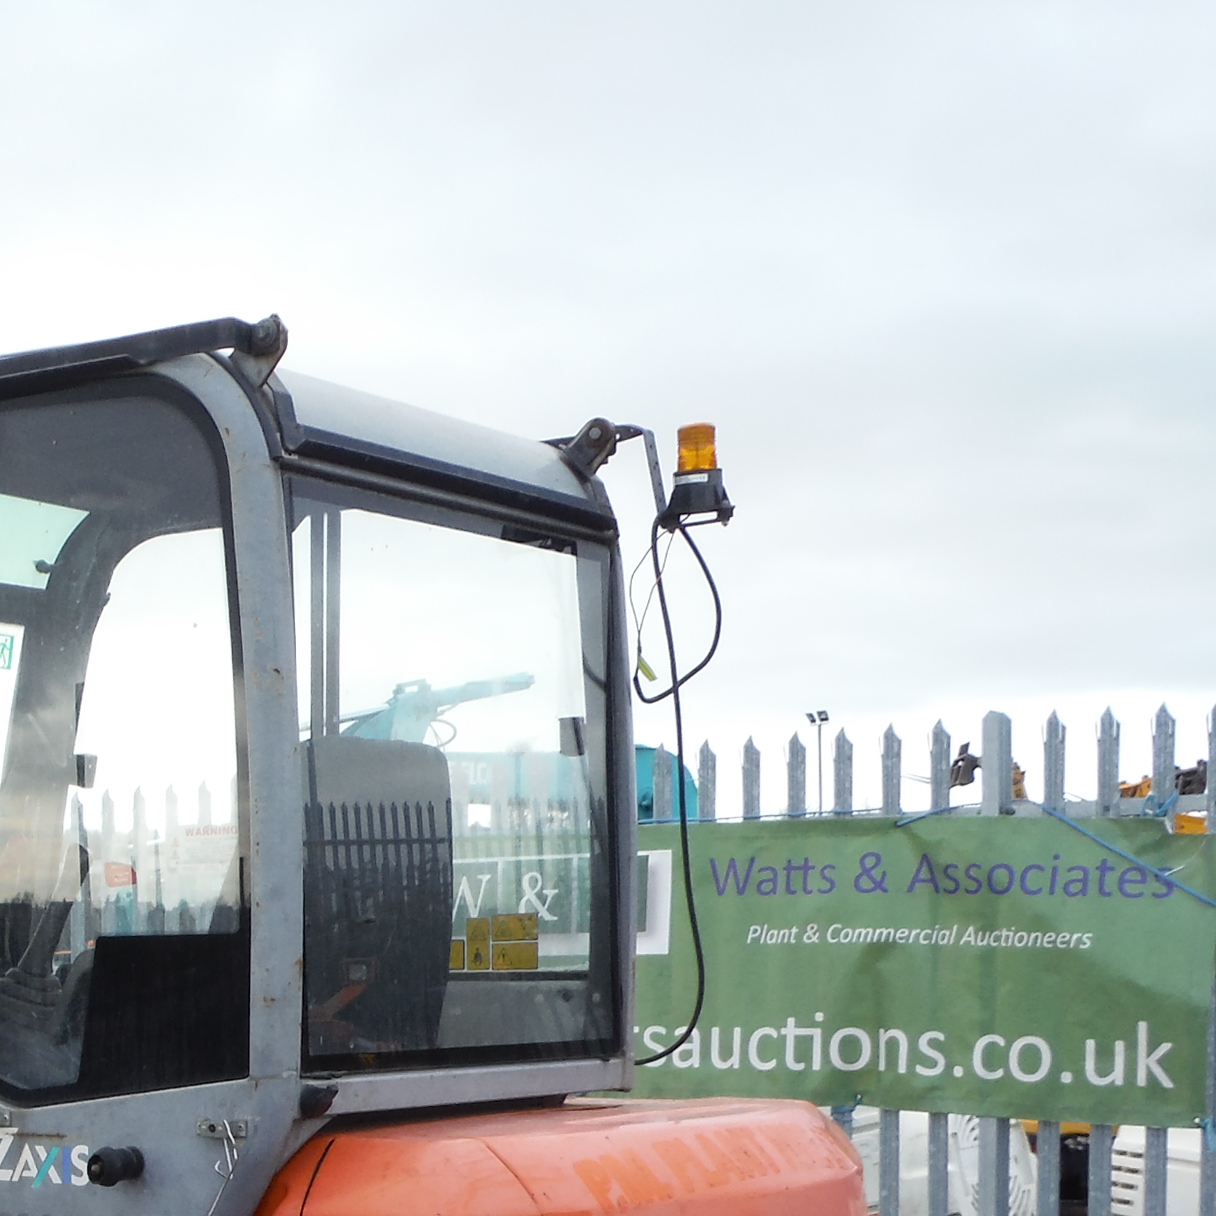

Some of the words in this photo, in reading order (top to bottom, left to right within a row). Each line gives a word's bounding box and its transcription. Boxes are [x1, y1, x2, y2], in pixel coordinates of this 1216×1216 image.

[709, 854, 836, 897] Watts
[853, 851, 889, 895] &
[906, 853, 1176, 899] Associates
[747, 923, 798, 945] Plant
[803, 924, 821, 944] &
[826, 923, 958, 946] Commercial
[960, 926, 1094, 950] Auctioneers
[633, 1012, 1175, 1089] sauctions.co.uk
